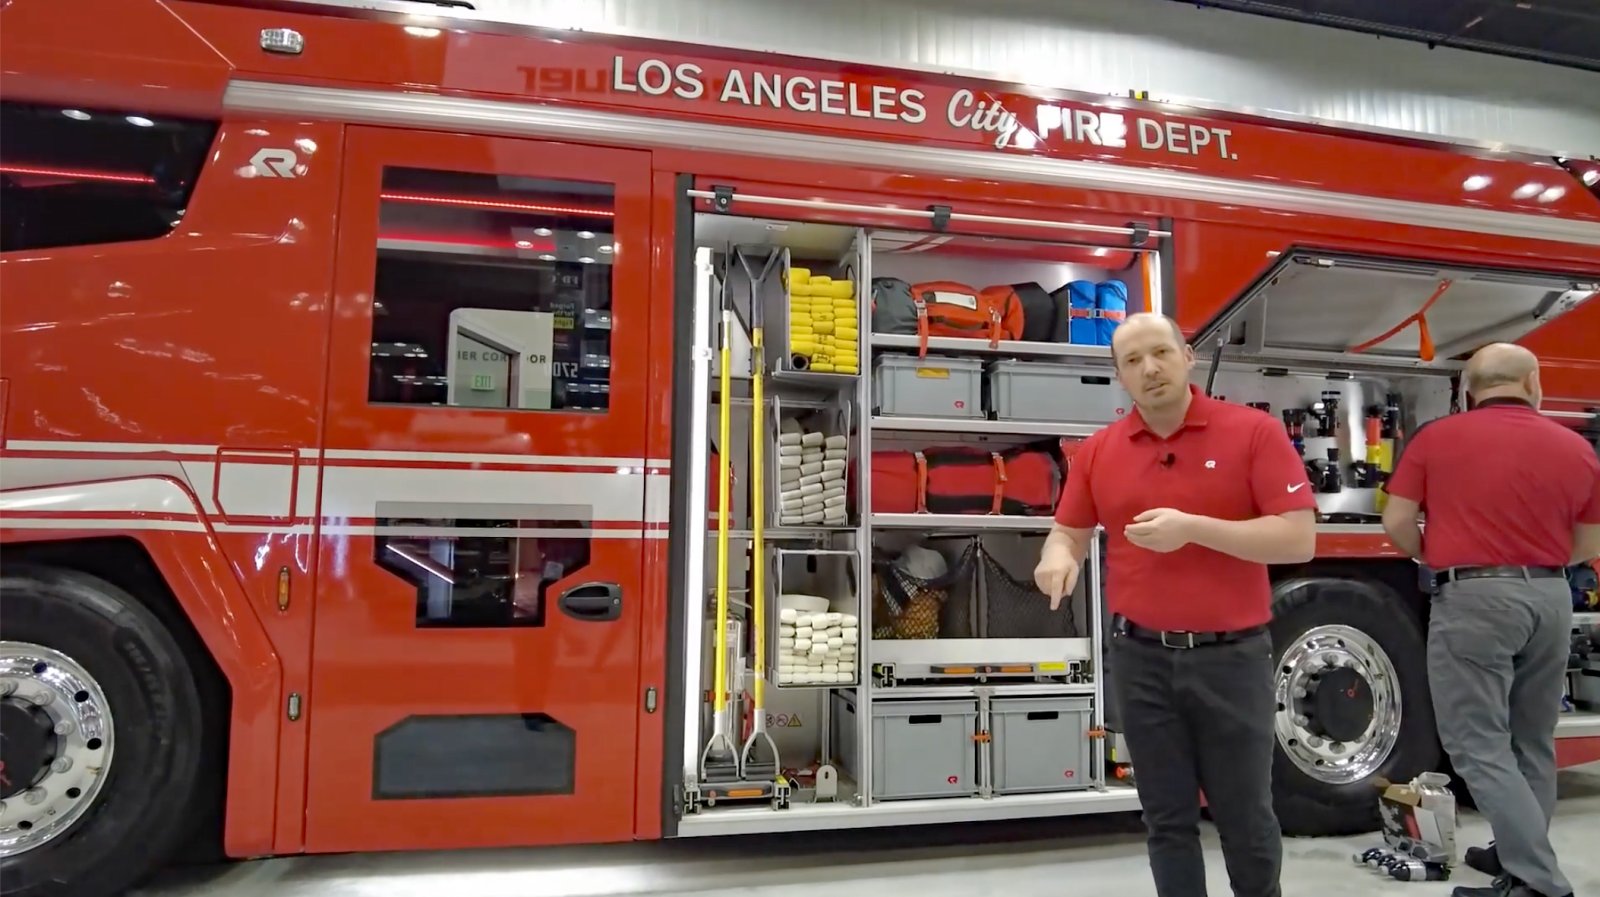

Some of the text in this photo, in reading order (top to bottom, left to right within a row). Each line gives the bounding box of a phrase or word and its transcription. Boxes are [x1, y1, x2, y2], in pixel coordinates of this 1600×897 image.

[612, 55, 705, 99] LOS
[720, 68, 927, 124] ANGELES
[947, 88, 1018, 149] City
[1136, 116, 1239, 161] DEPT.
